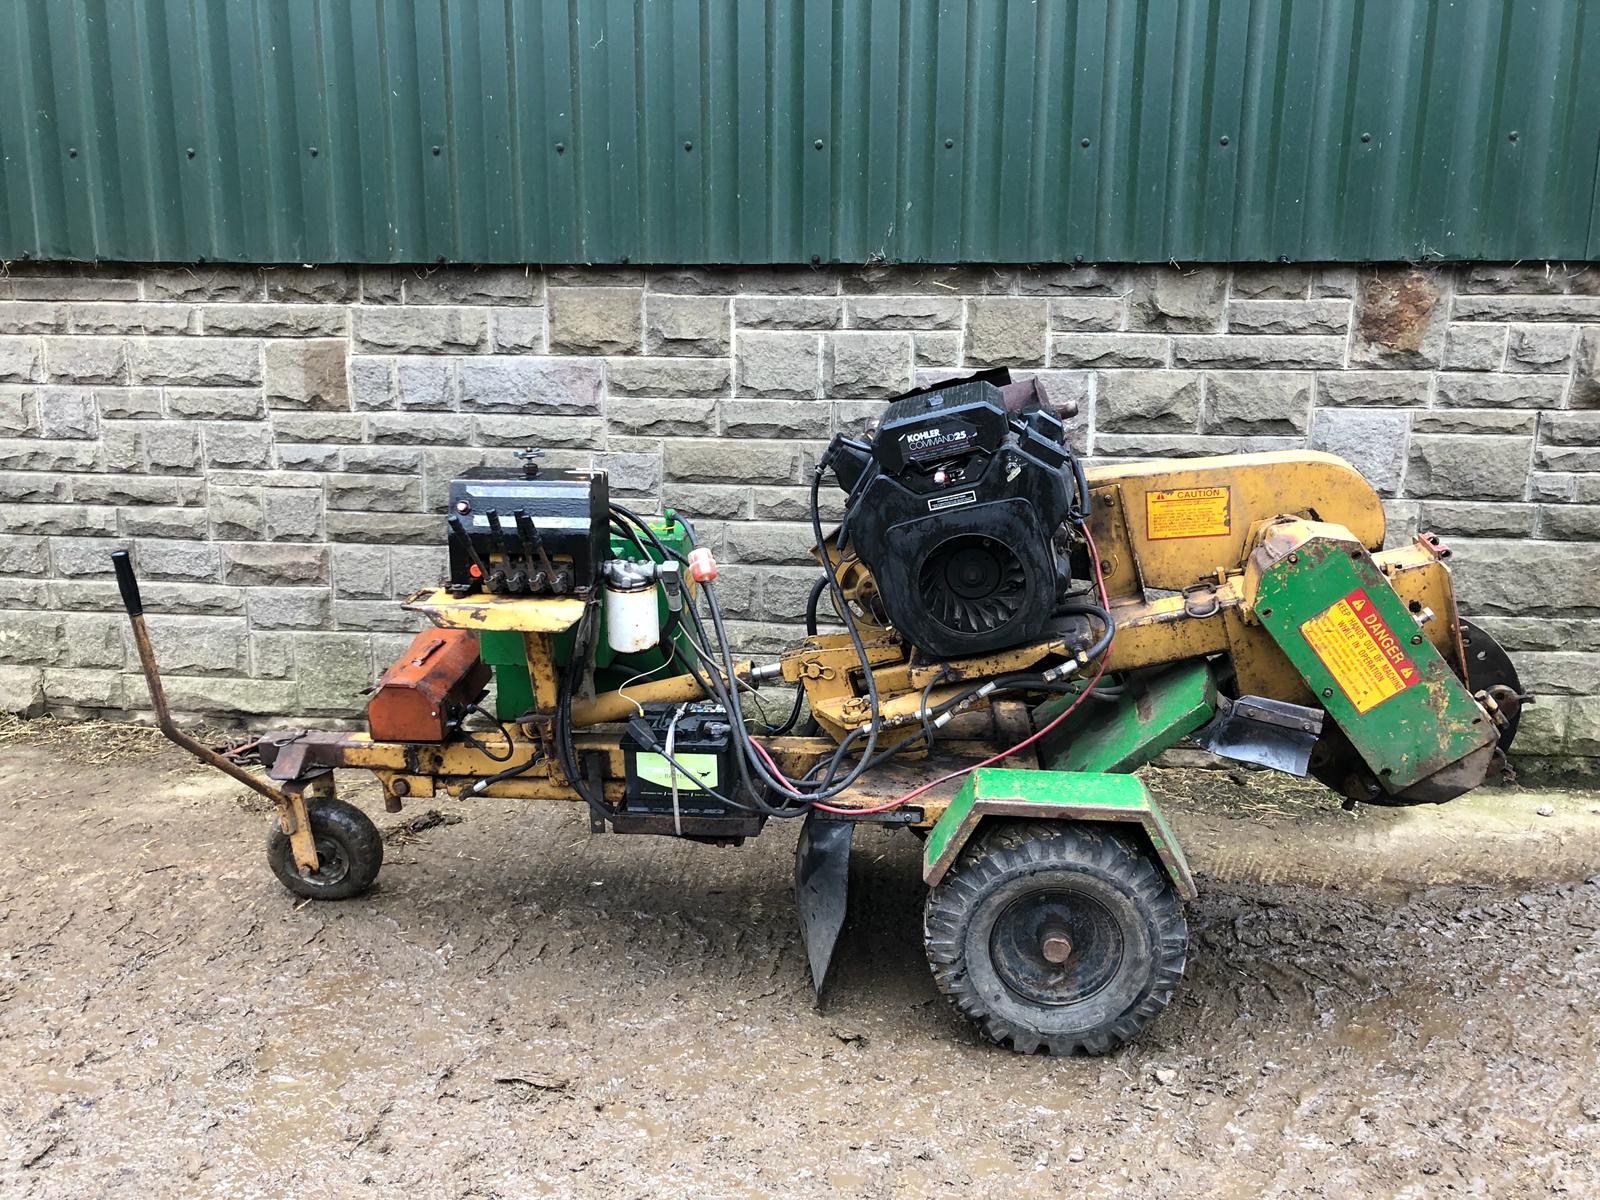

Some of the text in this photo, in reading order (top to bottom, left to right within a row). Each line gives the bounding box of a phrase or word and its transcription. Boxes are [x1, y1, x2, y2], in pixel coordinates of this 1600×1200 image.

[907, 429, 940, 443] KOHLER
[1177, 489, 1220, 499] CAUTION
[1337, 602, 1405, 690] KEEP HANDS OUT OF MACHINE
[1337, 620, 1385, 682] WHILE IN OPERATION
[1364, 613, 1405, 665] DANGER
